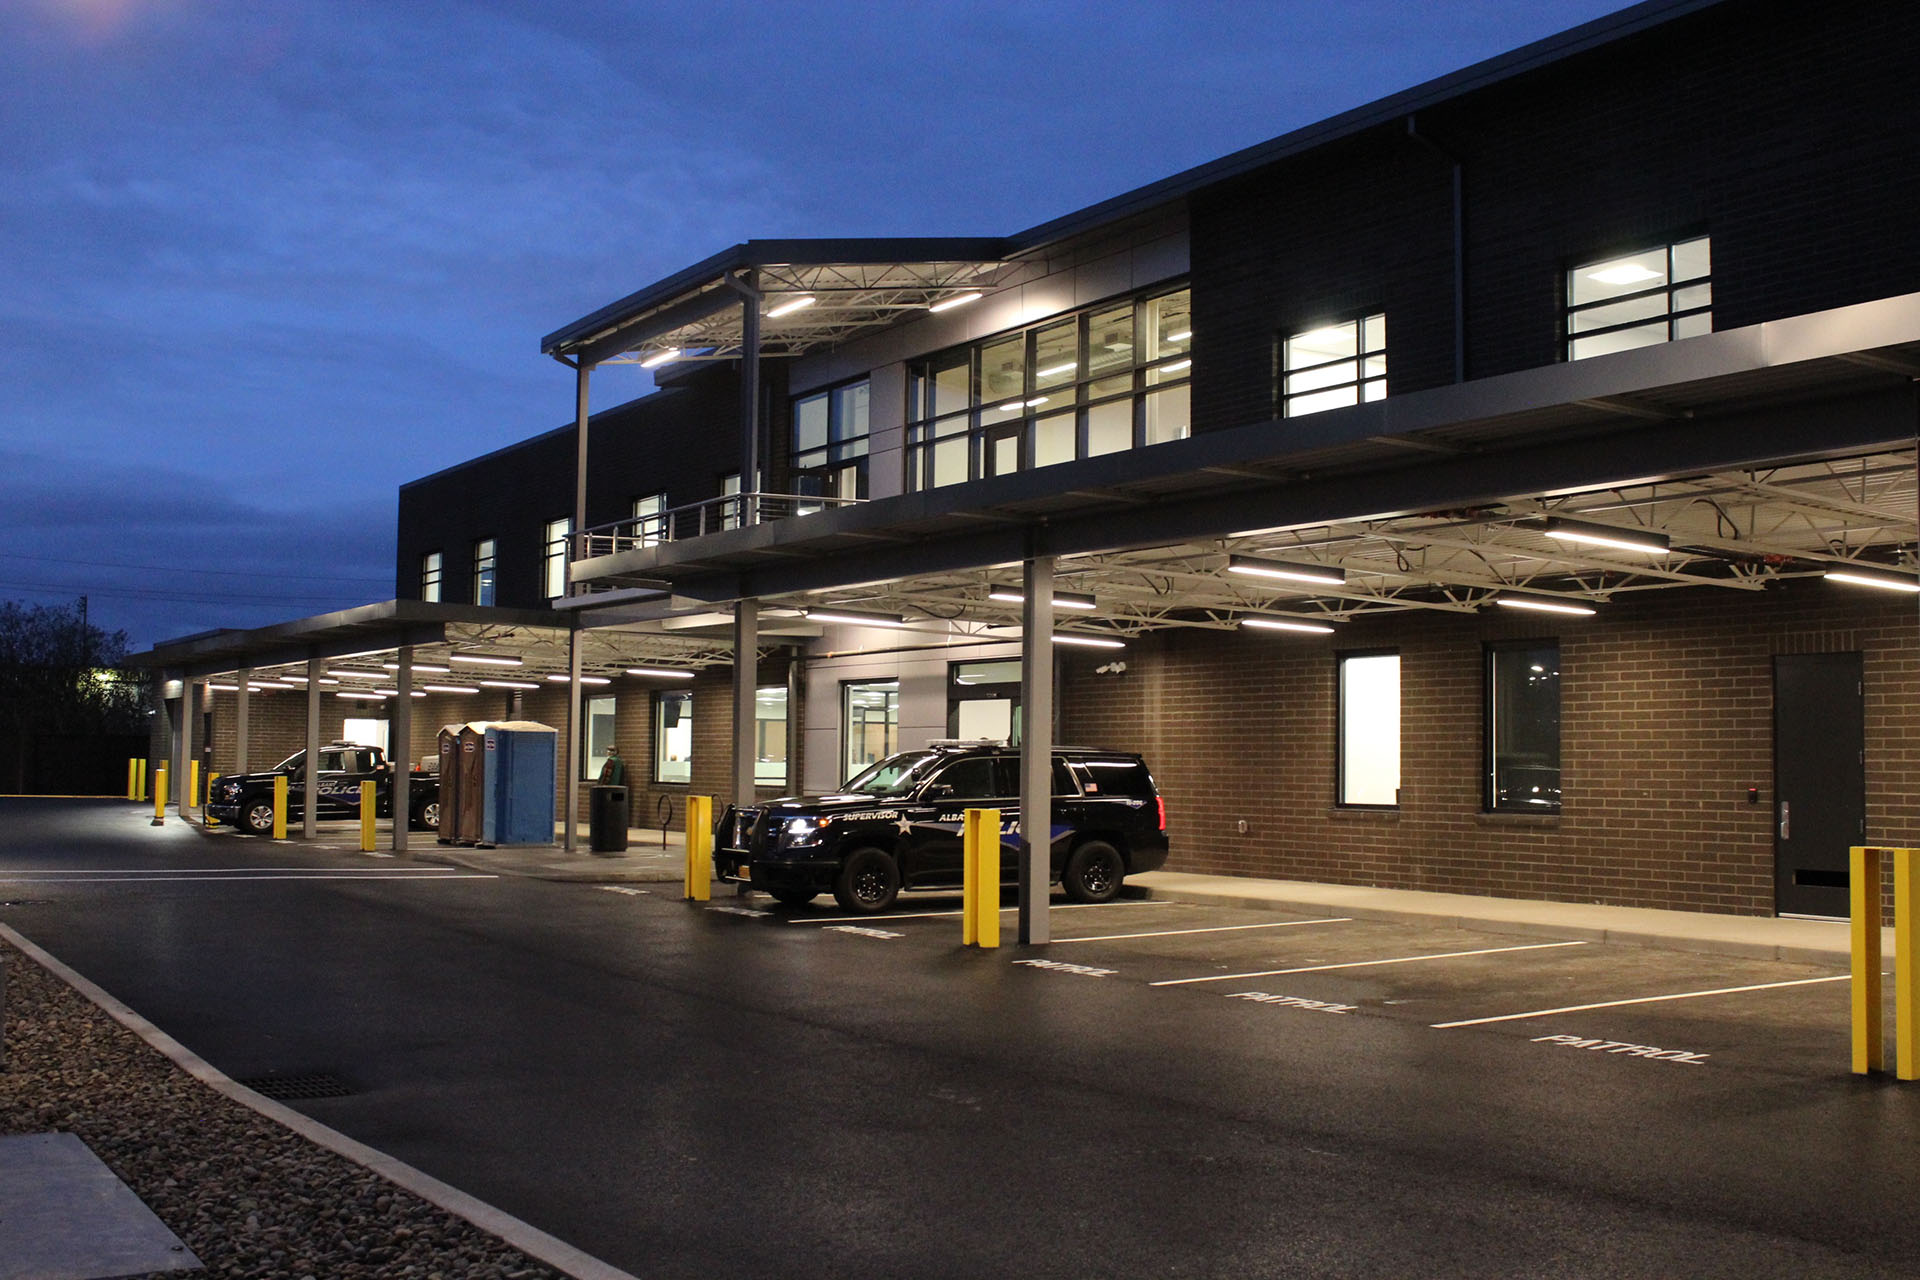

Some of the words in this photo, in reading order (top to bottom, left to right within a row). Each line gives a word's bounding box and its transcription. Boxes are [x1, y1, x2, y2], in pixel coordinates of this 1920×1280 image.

[316, 785, 362, 795] OLIC
[842, 811, 899, 821] SUPERVISOR
[938, 814, 965, 822] ALBA
[1224, 991, 1358, 1013] PATROL
[1529, 1034, 1711, 1065] PATROL
